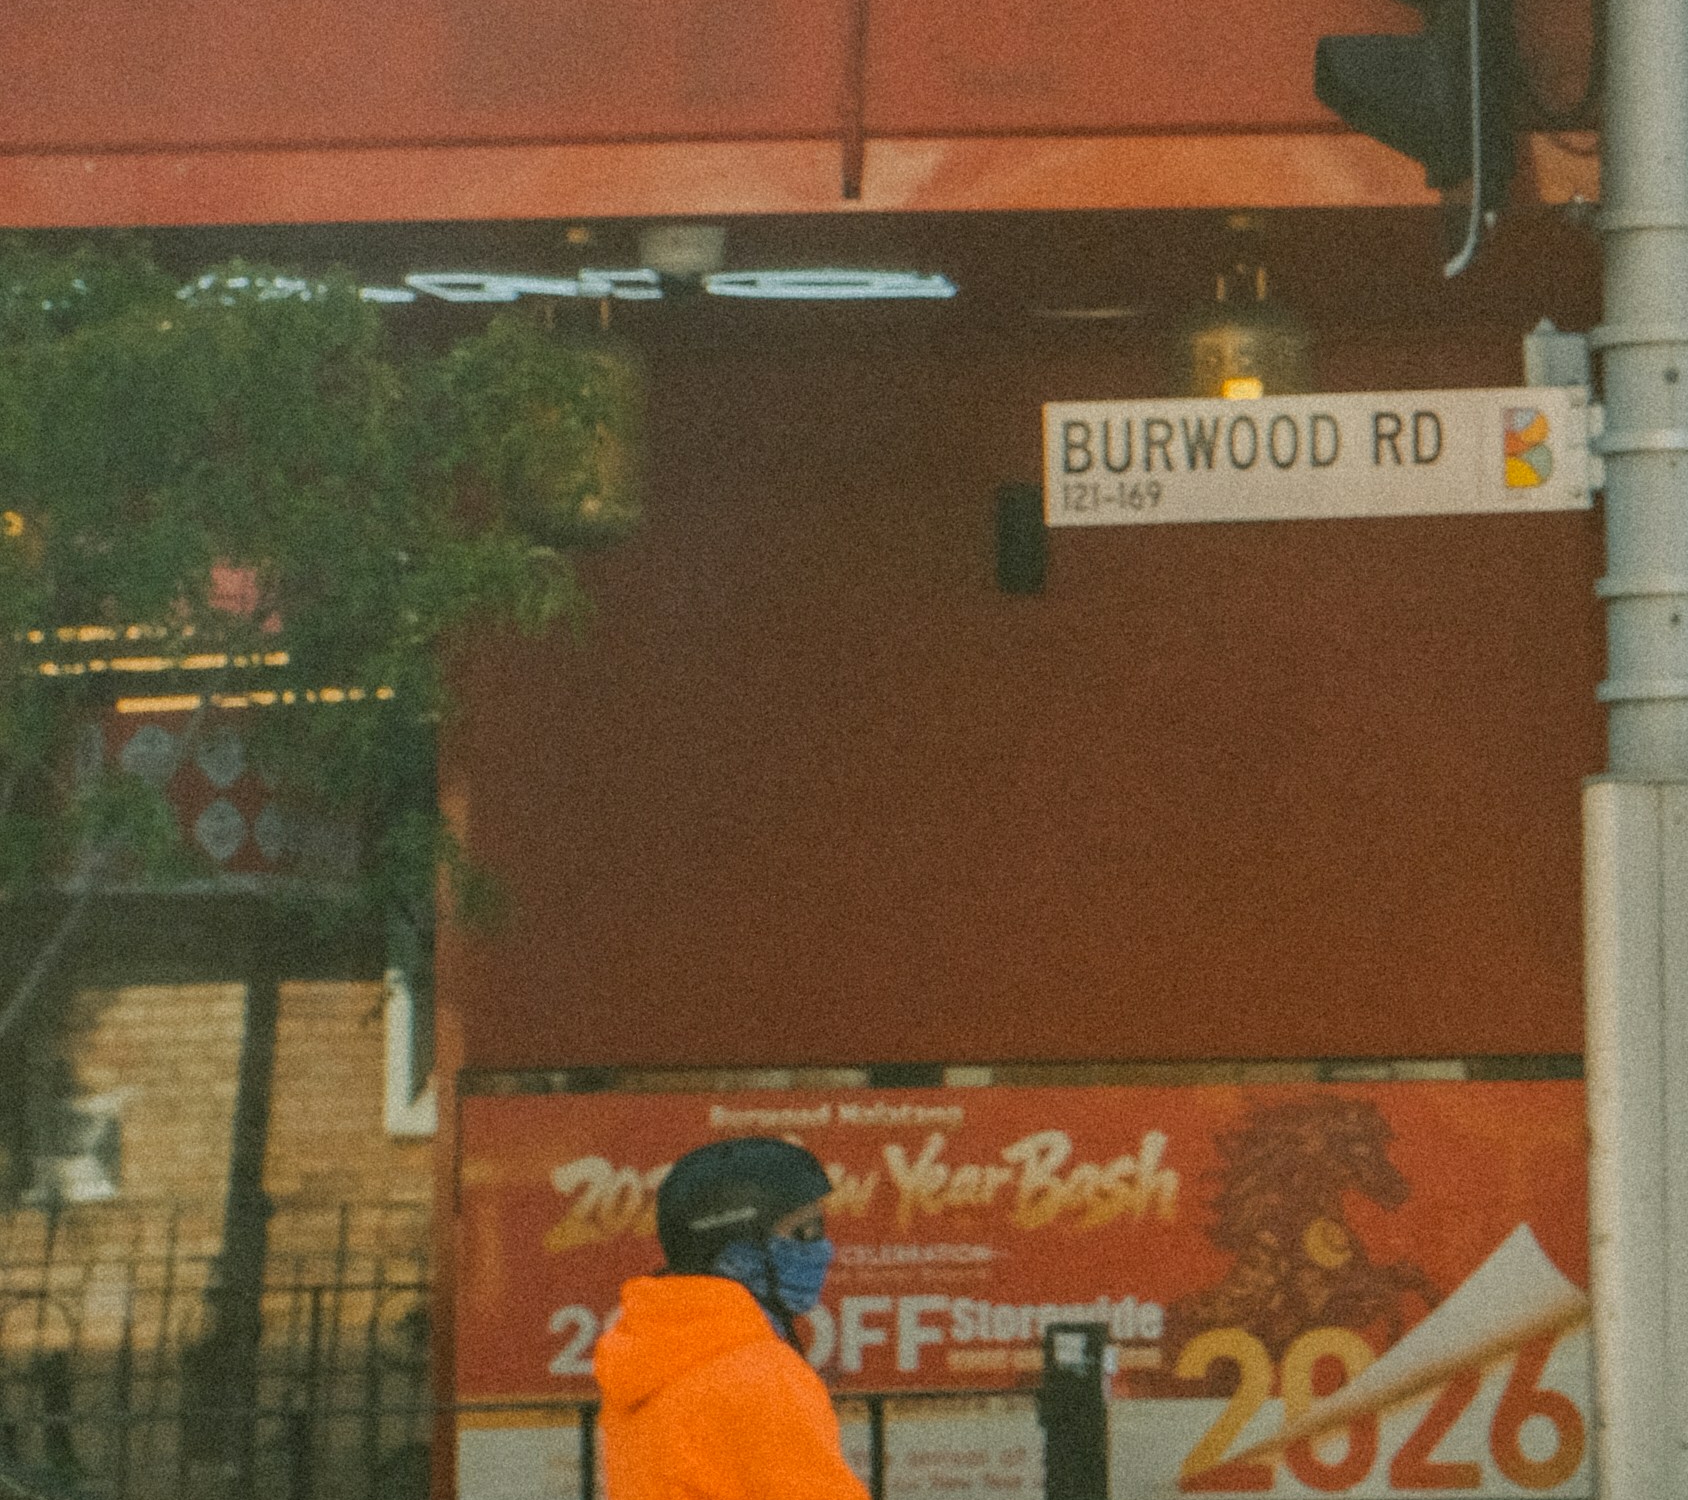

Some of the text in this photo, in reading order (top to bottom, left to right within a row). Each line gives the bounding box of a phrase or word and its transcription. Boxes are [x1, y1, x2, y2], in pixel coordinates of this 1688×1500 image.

[1061, 408, 1445, 476] BURWOOD RD
[1061, 480, 1163, 513] 121-169
[883, 1132, 1012, 1233] Year
[1003, 1130, 1180, 1232] Bash
[1175, 1326, 1587, 1493] 2026
